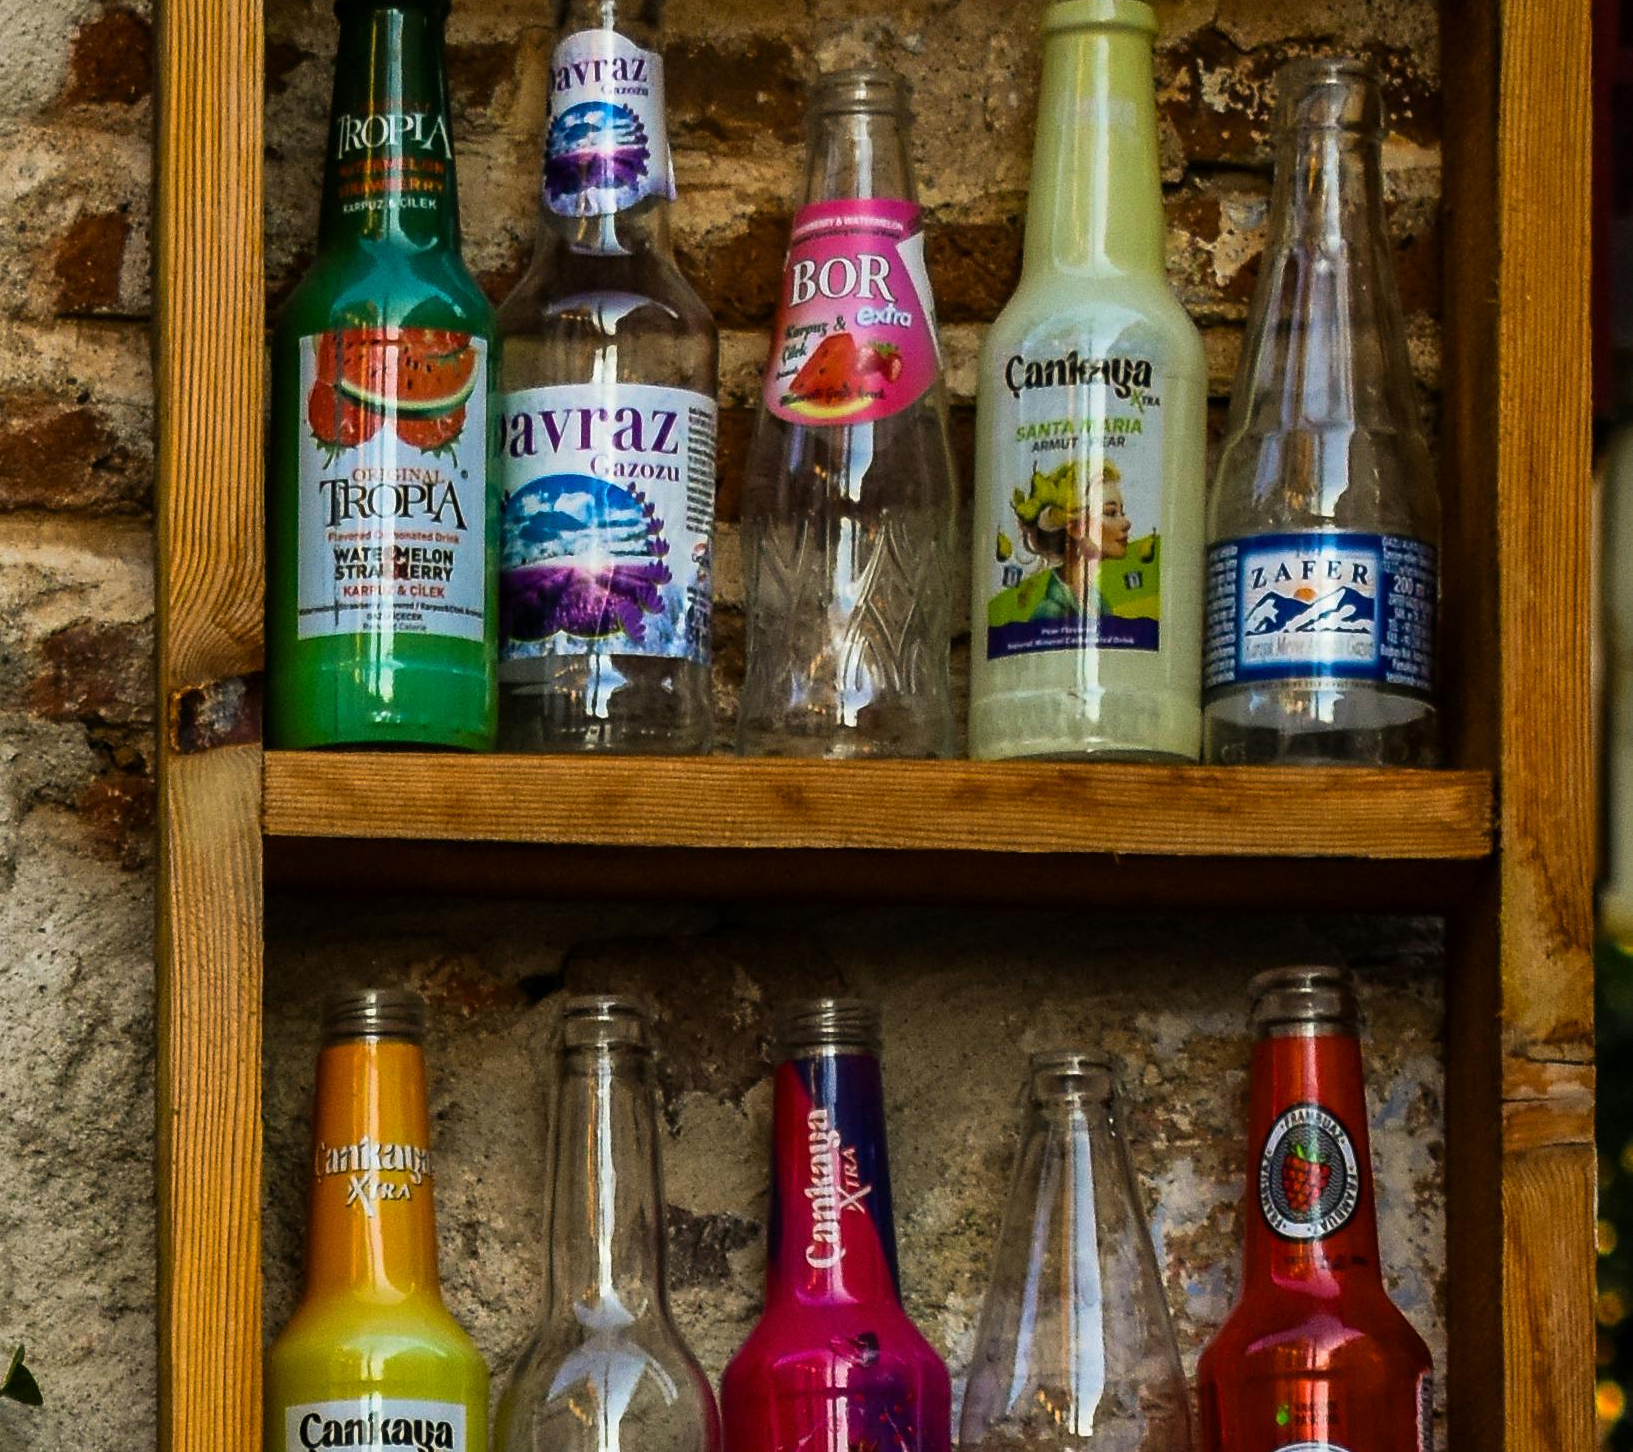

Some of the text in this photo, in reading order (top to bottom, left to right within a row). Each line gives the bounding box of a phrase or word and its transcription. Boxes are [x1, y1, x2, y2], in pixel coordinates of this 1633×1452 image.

[337, 111, 454, 161] TROPIA
[789, 253, 897, 308] BOR
[855, 303, 913, 330] extra
[1005, 350, 1153, 399] Çankaya
[1016, 419, 1075, 443] SANTA
[1031, 436, 1079, 453] ARMUT
[590, 452, 682, 483] Gazozu
[319, 478, 468, 531] TROPIA
[333, 546, 454, 566] WATEMELON
[334, 563, 454, 582] STRABERRY
[1251, 559, 1370, 589] ZAFER
[346, 1171, 411, 1218] XTRA
[804, 1109, 846, 1269] Çankaya
[837, 1146, 872, 1215] XTRA
